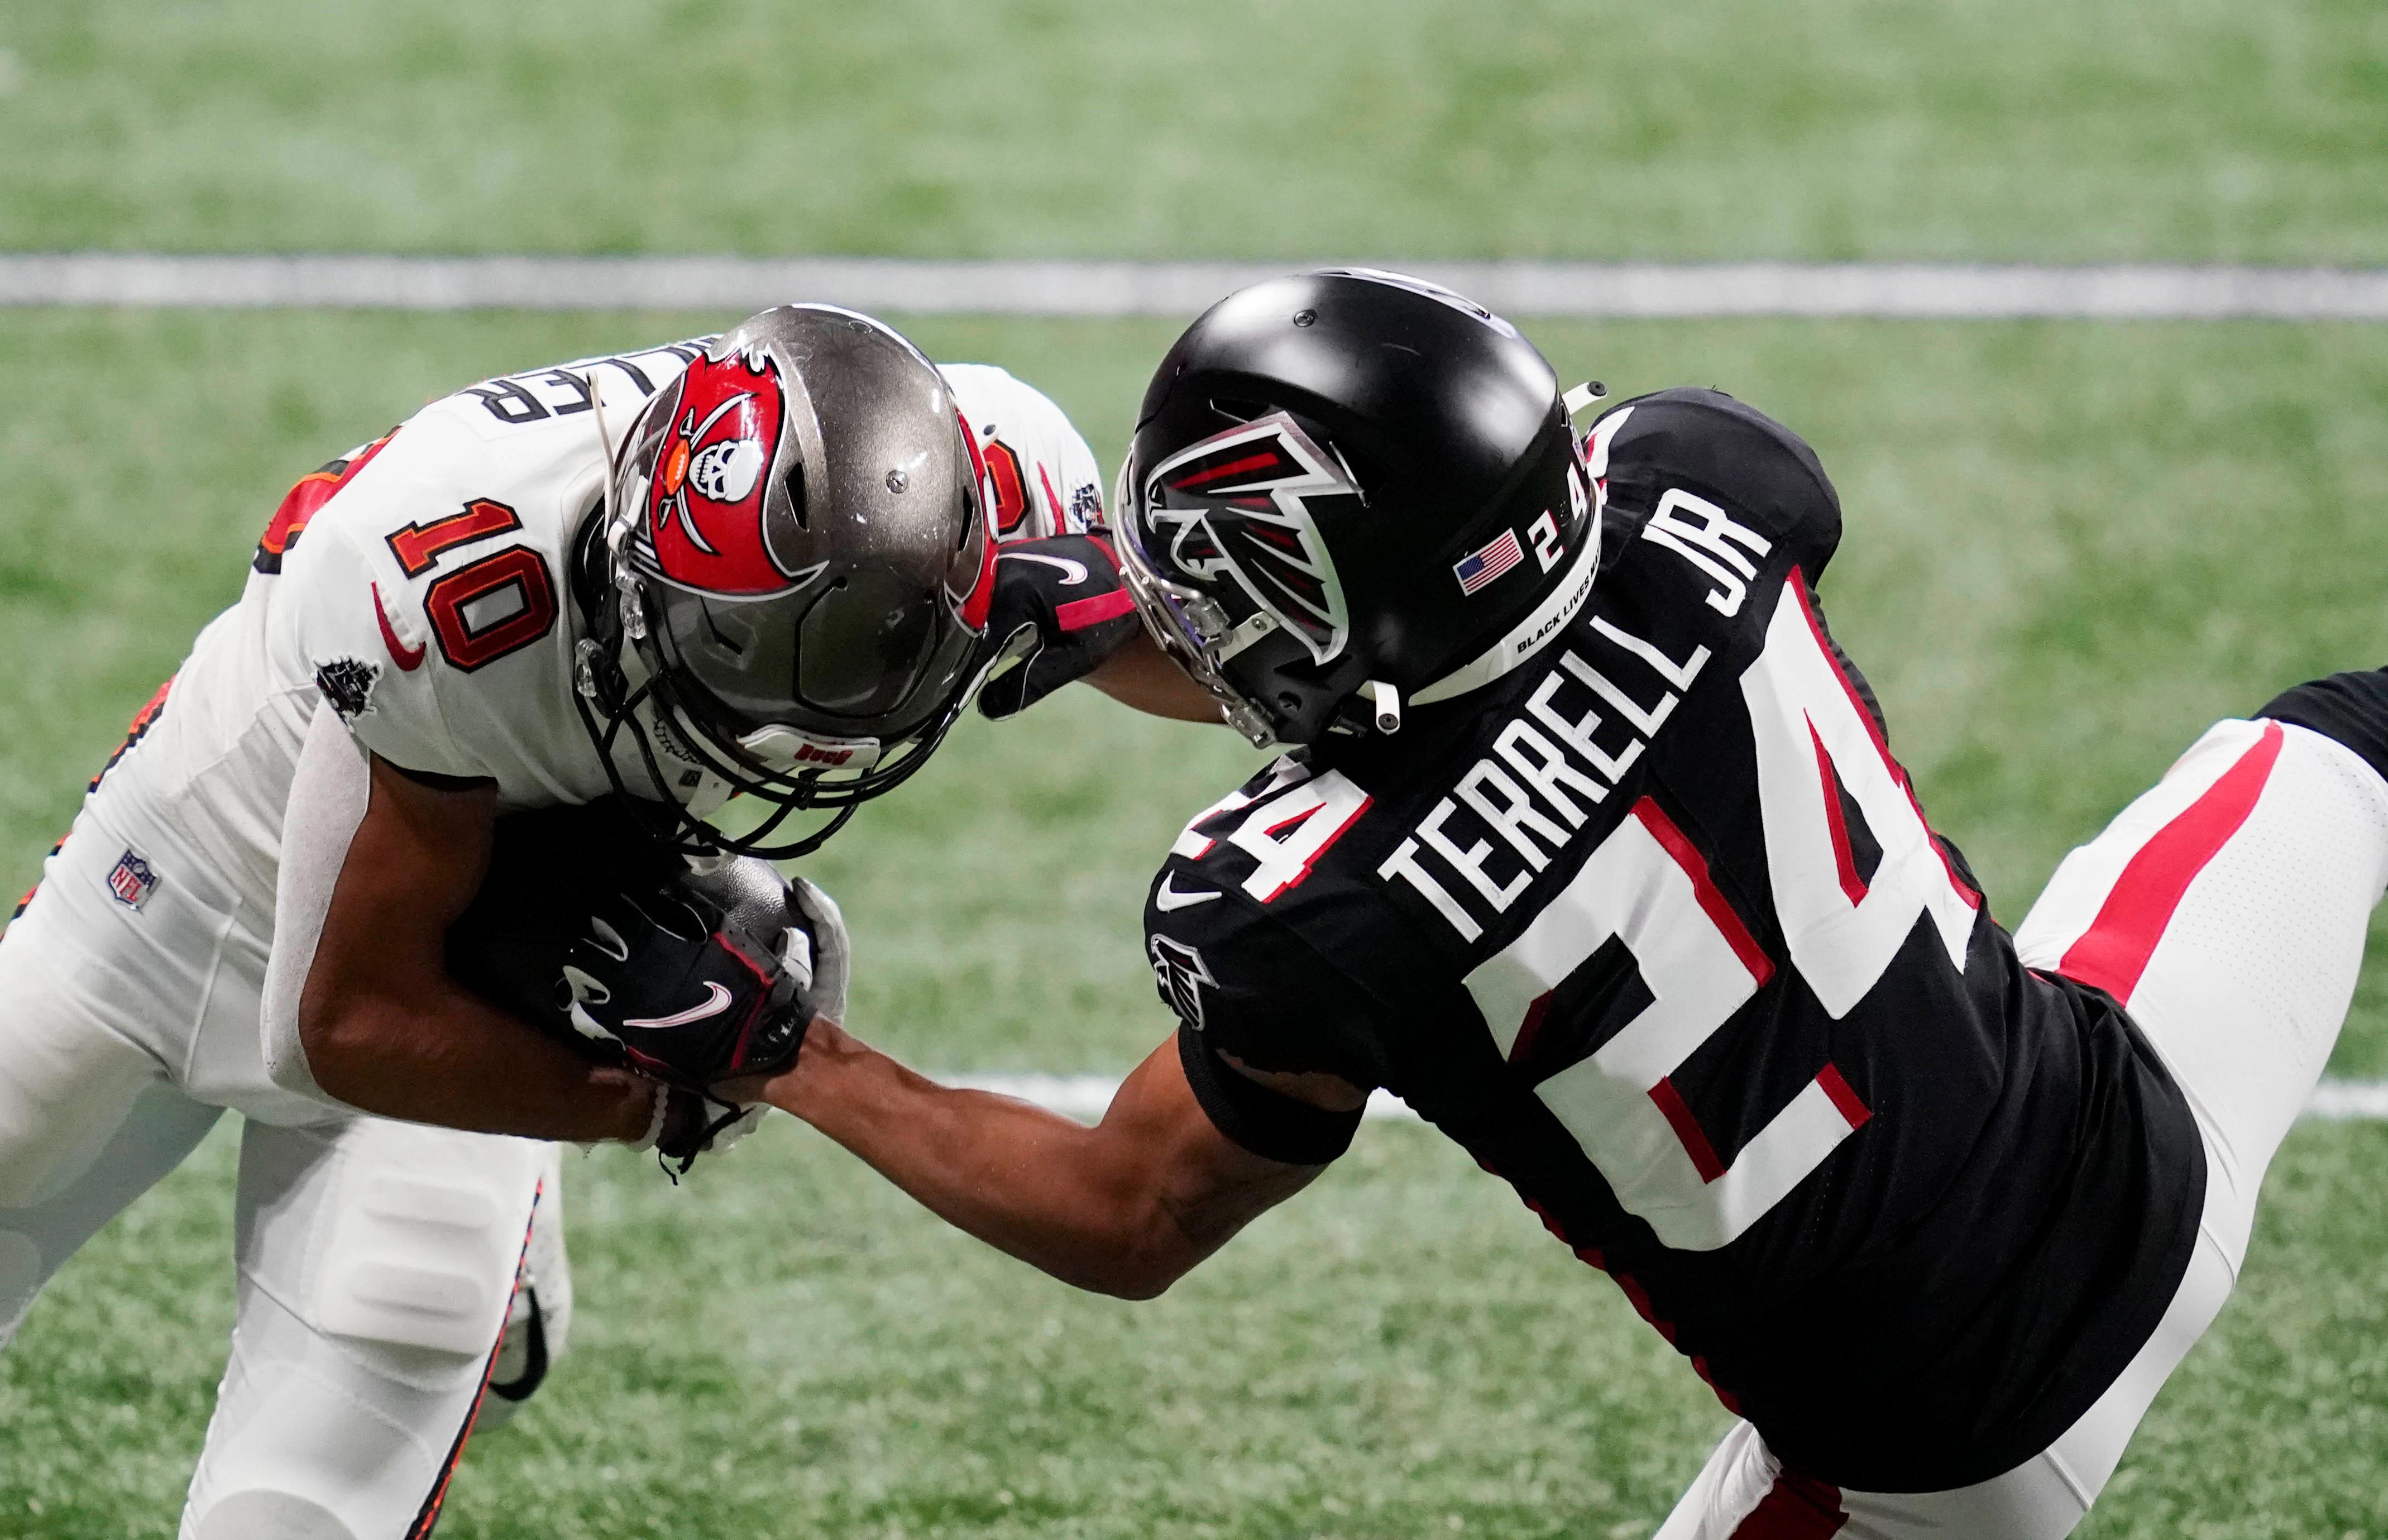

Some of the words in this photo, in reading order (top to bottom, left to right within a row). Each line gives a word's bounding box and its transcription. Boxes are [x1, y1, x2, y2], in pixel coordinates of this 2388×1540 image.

[385, 498, 559, 673] 10
[1517, 612, 1561, 654] BLACK
[1563, 575, 1590, 616] LIVES
[1376, 615, 1712, 944] TERRELL
[1641, 488, 1772, 618] JR
[111, 866, 140, 902] NFL
[1461, 563, 1982, 1252] 24
